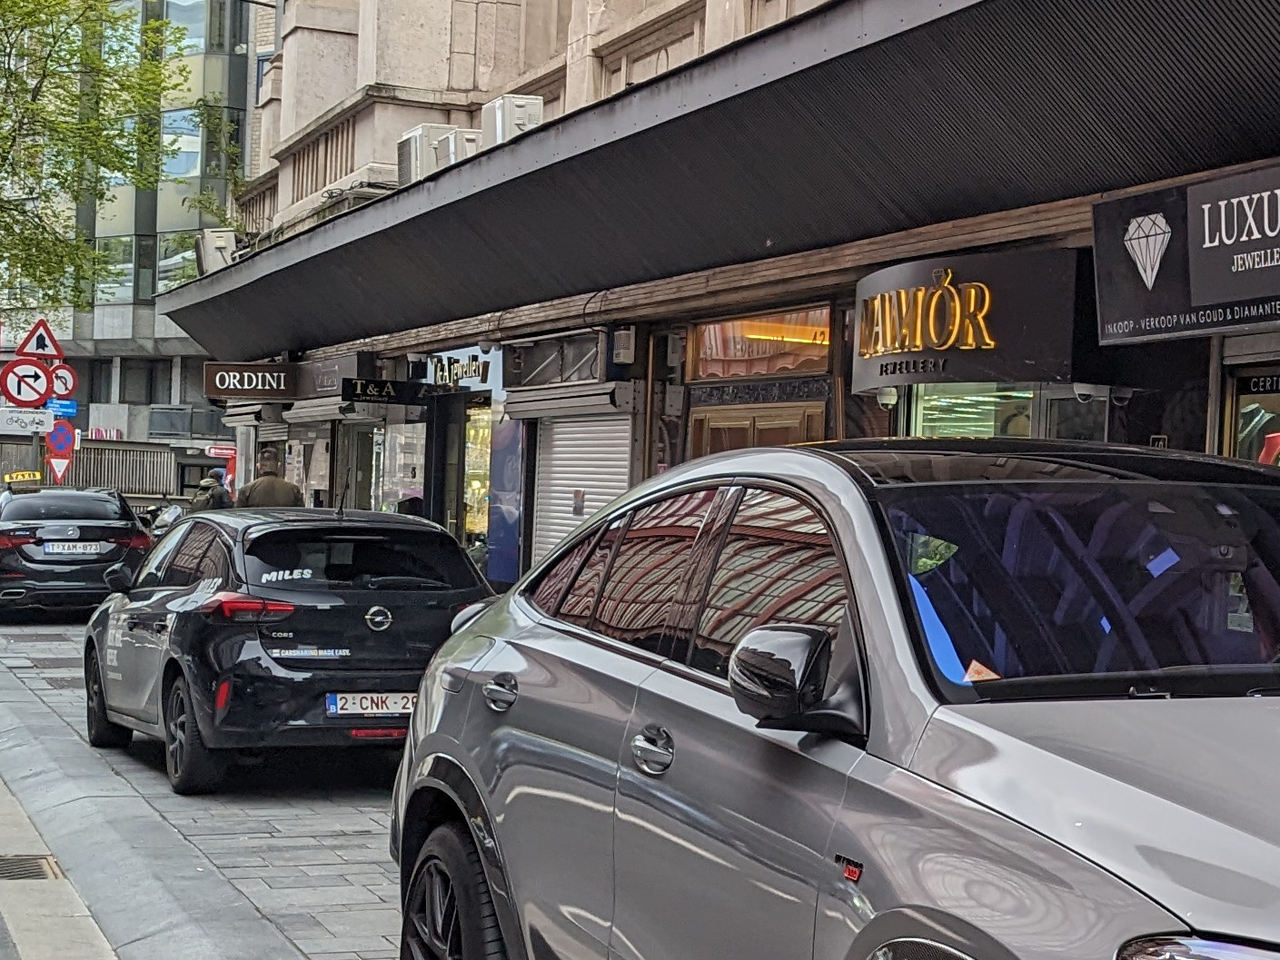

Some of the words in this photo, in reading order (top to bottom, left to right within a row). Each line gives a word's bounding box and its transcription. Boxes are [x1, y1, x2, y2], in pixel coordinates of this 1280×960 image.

[1105, 320, 1134, 335] INKOOP
[1140, 315, 1178, 331] VERKOOP
[1179, 312, 1198, 326] VAN
[1198, 309, 1224, 324] GOUD
[1226, 308, 1232, 320] &
[879, 358, 948, 376] JEWELLERY
[215, 371, 287, 390] ORDINI
[261, 569, 313, 583] MILES
